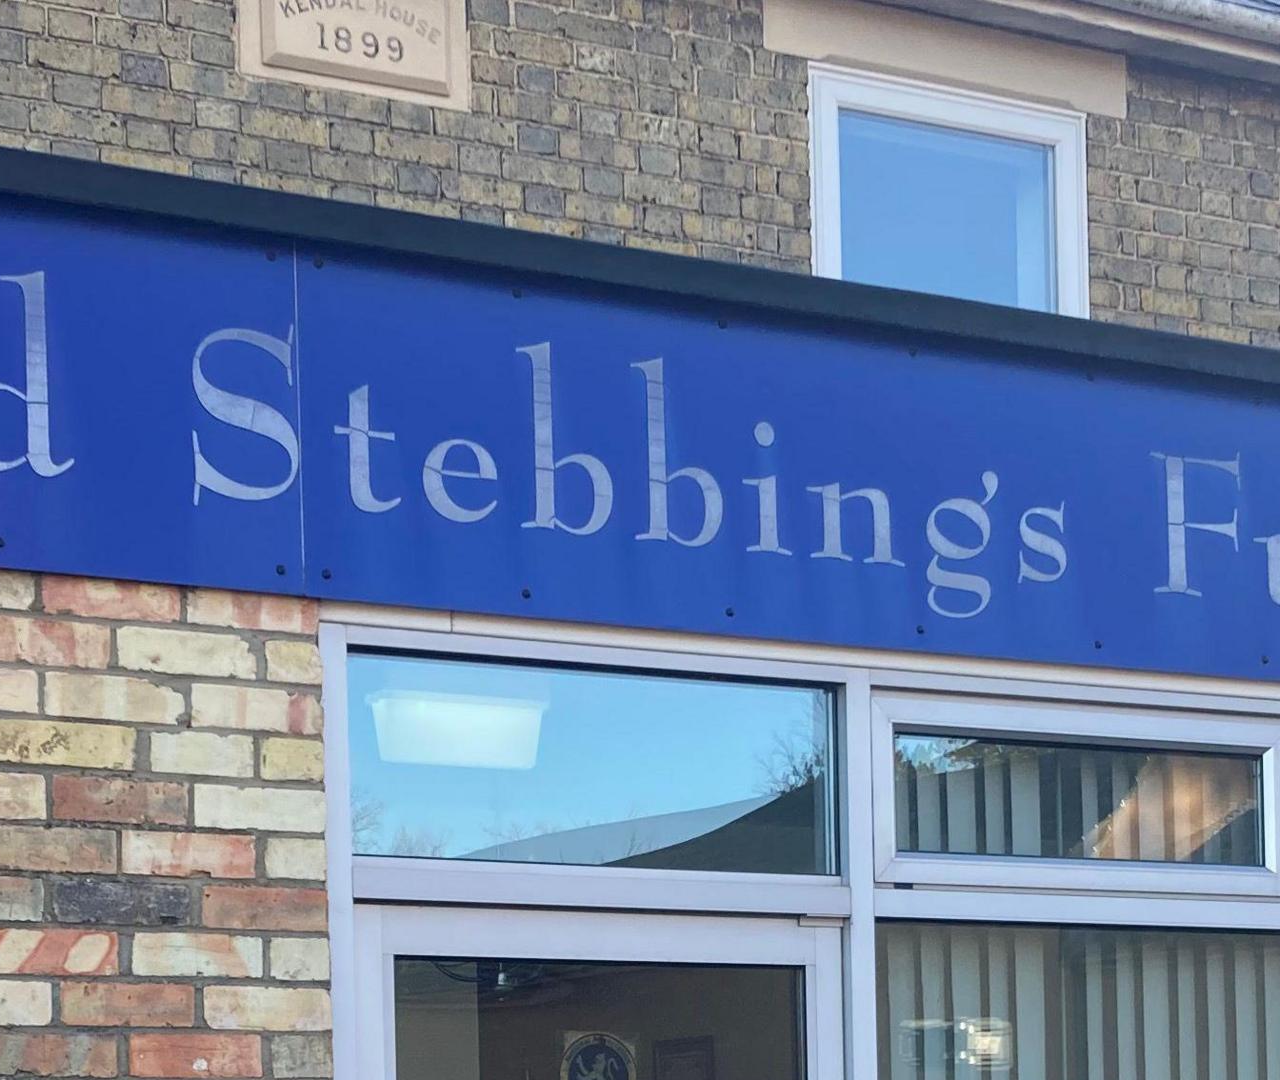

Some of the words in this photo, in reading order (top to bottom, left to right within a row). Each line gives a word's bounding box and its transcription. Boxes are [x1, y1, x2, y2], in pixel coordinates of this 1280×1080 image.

[316, 22, 404, 62] 1899
[375, 3, 441, 45] HOUSE
[192, 325, 1068, 618] Stebbings
